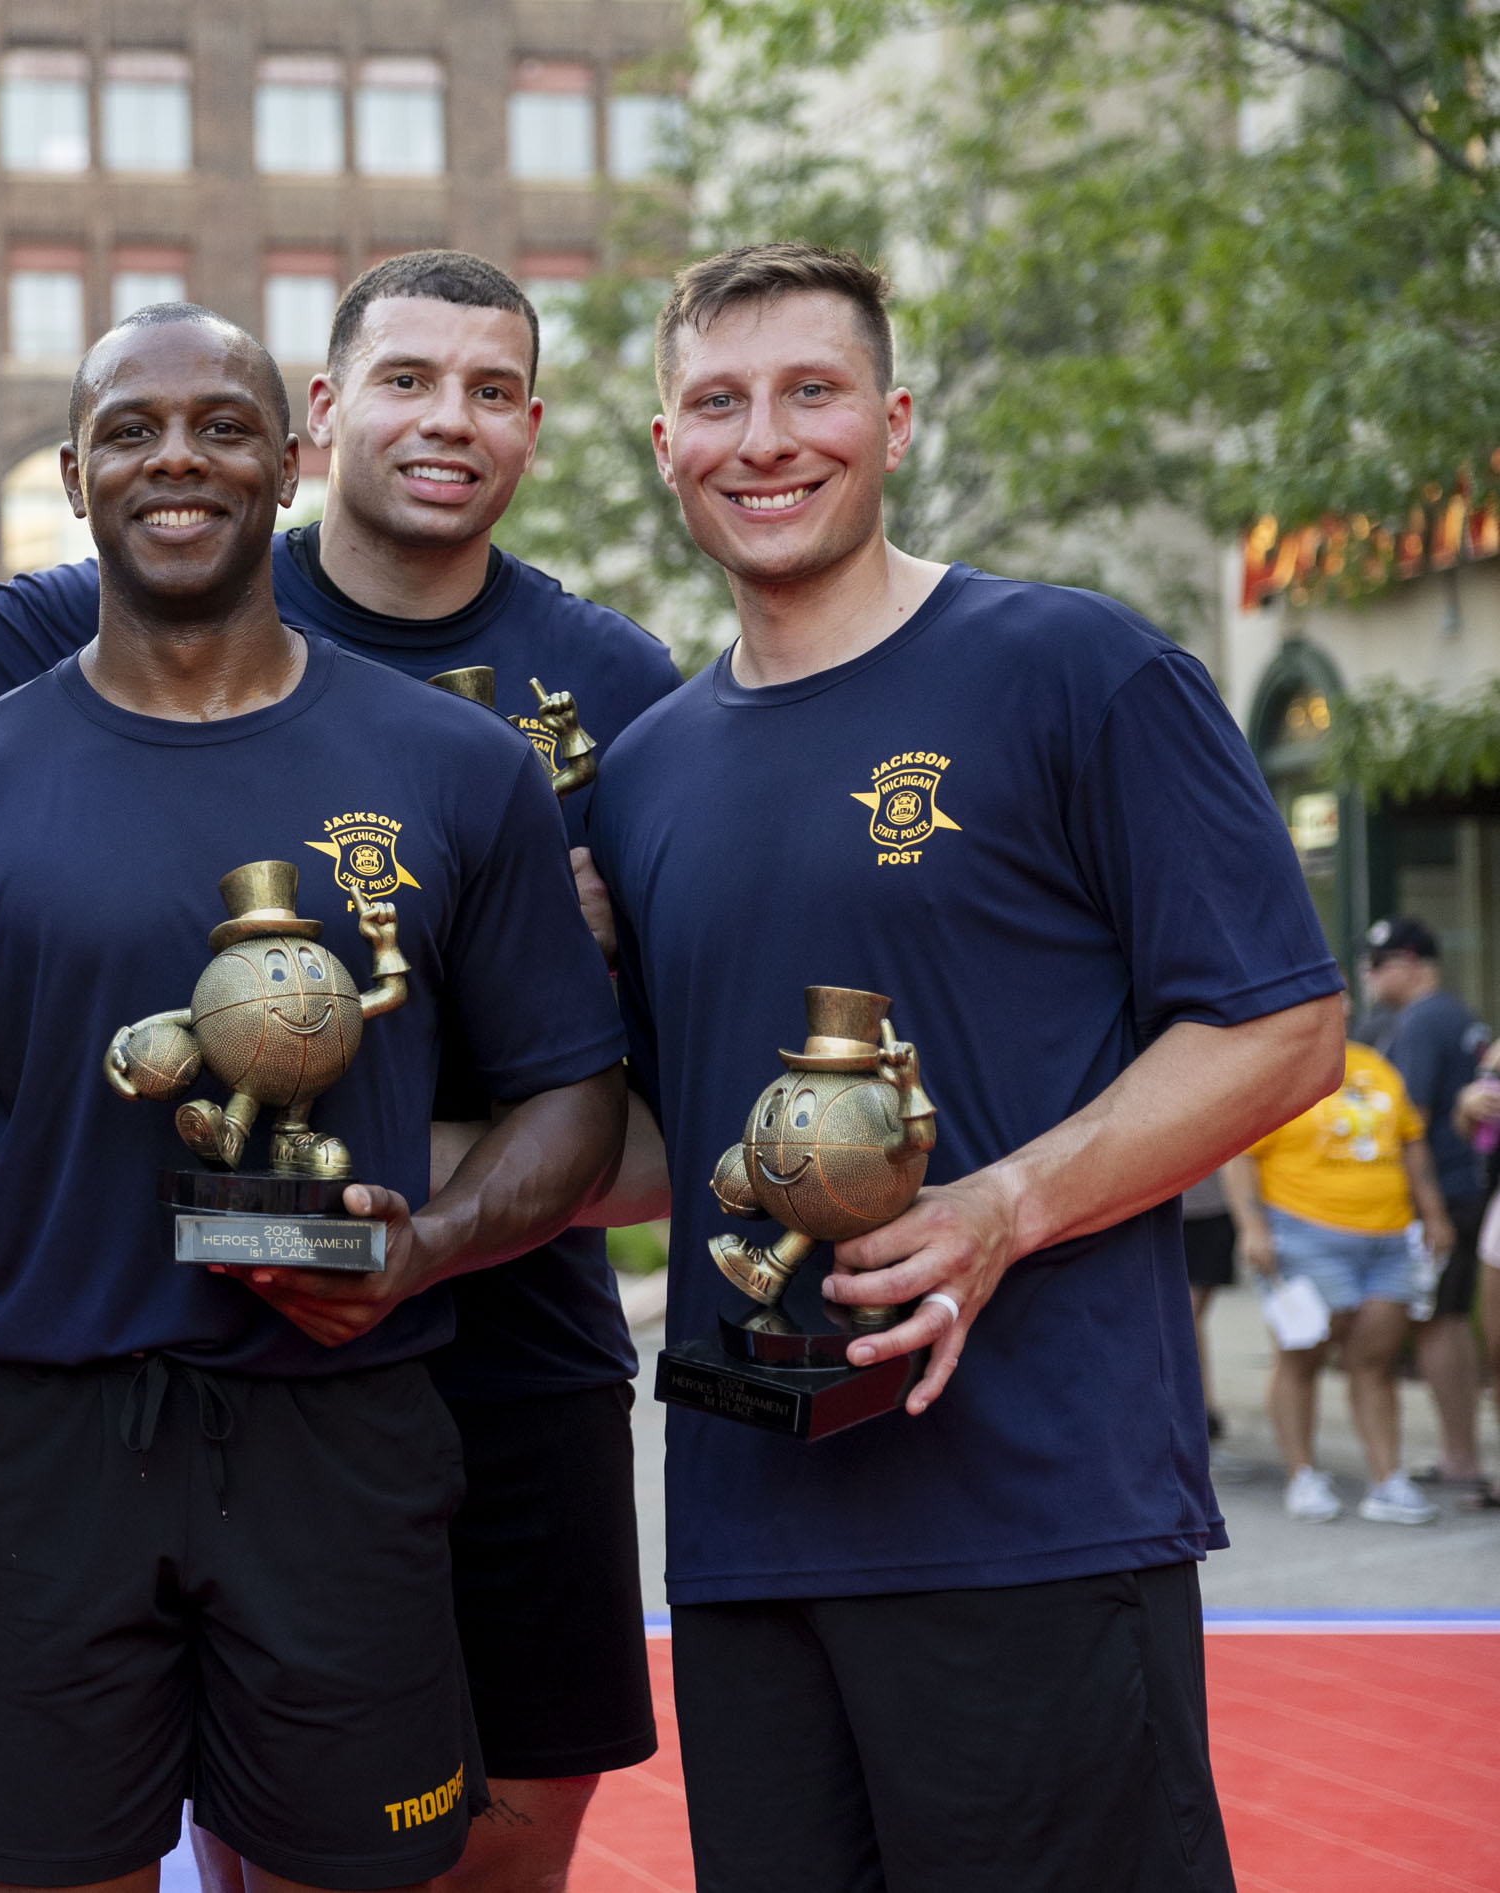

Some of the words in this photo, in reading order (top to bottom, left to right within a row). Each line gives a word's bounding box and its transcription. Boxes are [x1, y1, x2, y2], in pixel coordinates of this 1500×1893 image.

[871, 751, 951, 780] JACKSON
[880, 775, 934, 795] MICHIGAN
[323, 812, 403, 832] JACKSON
[874, 823, 899, 840] STATE
[901, 820, 931, 839] POLICE
[338, 831, 390, 847] MICHIGAN
[877, 851, 923, 866] POST
[340, 872, 366, 889] STATE
[368, 874, 396, 890] POLICE
[263, 1226, 301, 1237] 2024
[203, 1235, 259, 1247] HEROES
[266, 1236, 363, 1249] TOURNAMENT
[270, 1248, 317, 1259] PLACE
[717, 1376, 745, 1392] 2024
[671, 1375, 714, 1395] HEROES
[717, 1387, 790, 1416] TOURNAMENT
[719, 1399, 754, 1417] PLACE
